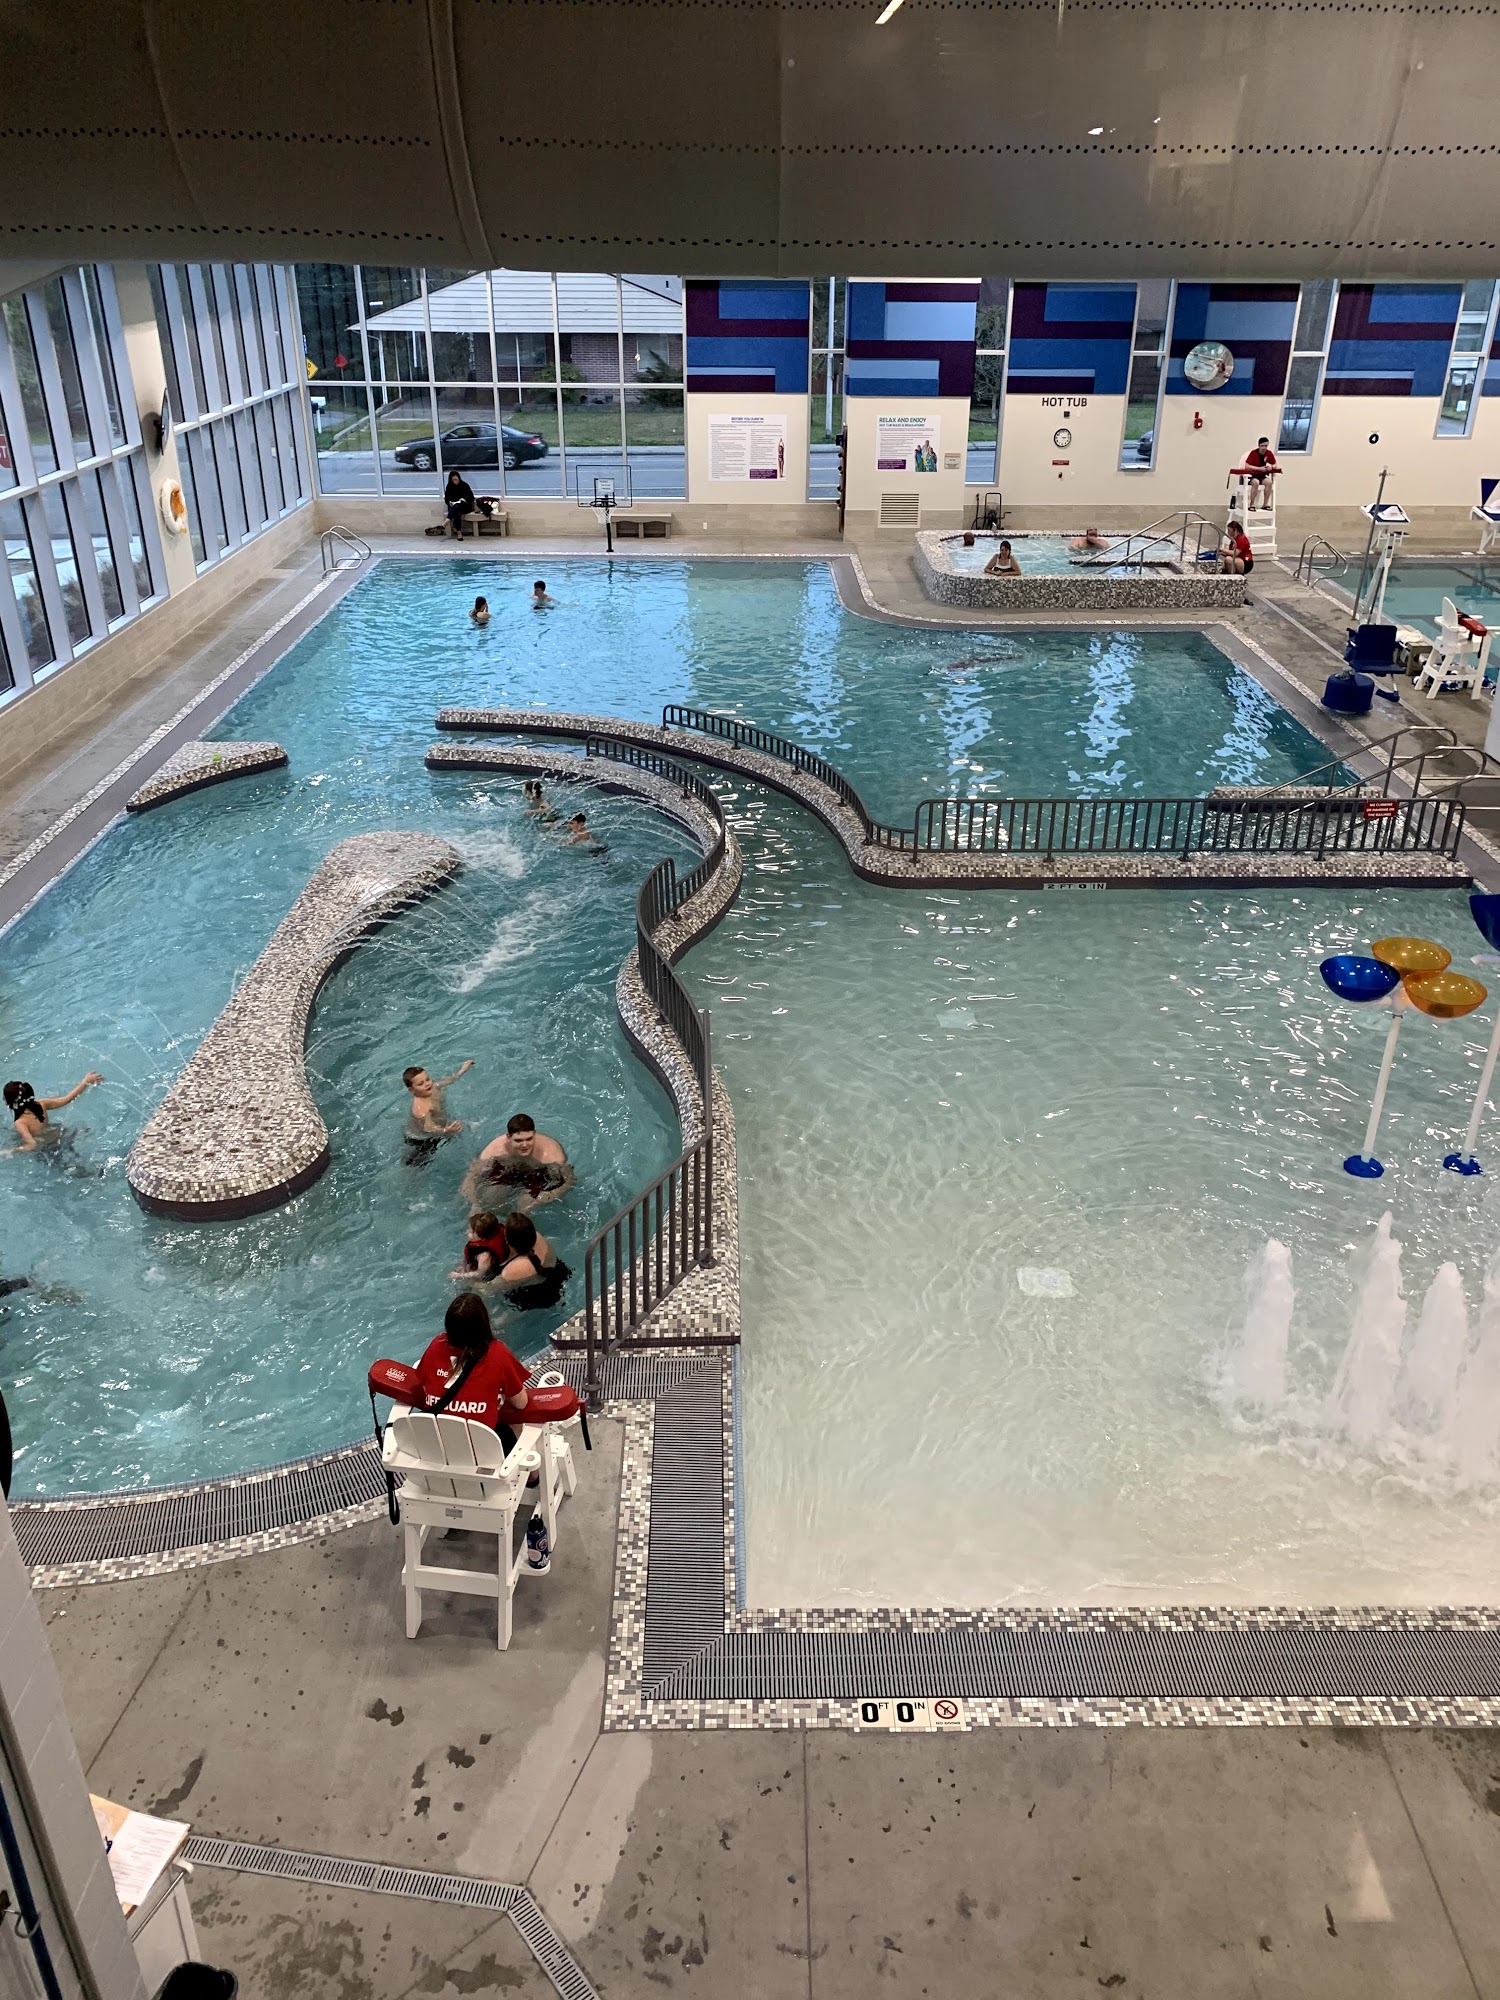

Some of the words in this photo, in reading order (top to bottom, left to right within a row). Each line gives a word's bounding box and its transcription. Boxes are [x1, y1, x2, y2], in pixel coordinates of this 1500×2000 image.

[1042, 397, 1064, 407] HOT
[1066, 397, 1088, 407] TUB
[436, 1368, 449, 1378] the
[425, 1394, 487, 1414] LIFUARD
[861, 1702, 879, 1723] 0
[896, 1702, 915, 1723] 0
[914, 1702, 925, 1710] IN
